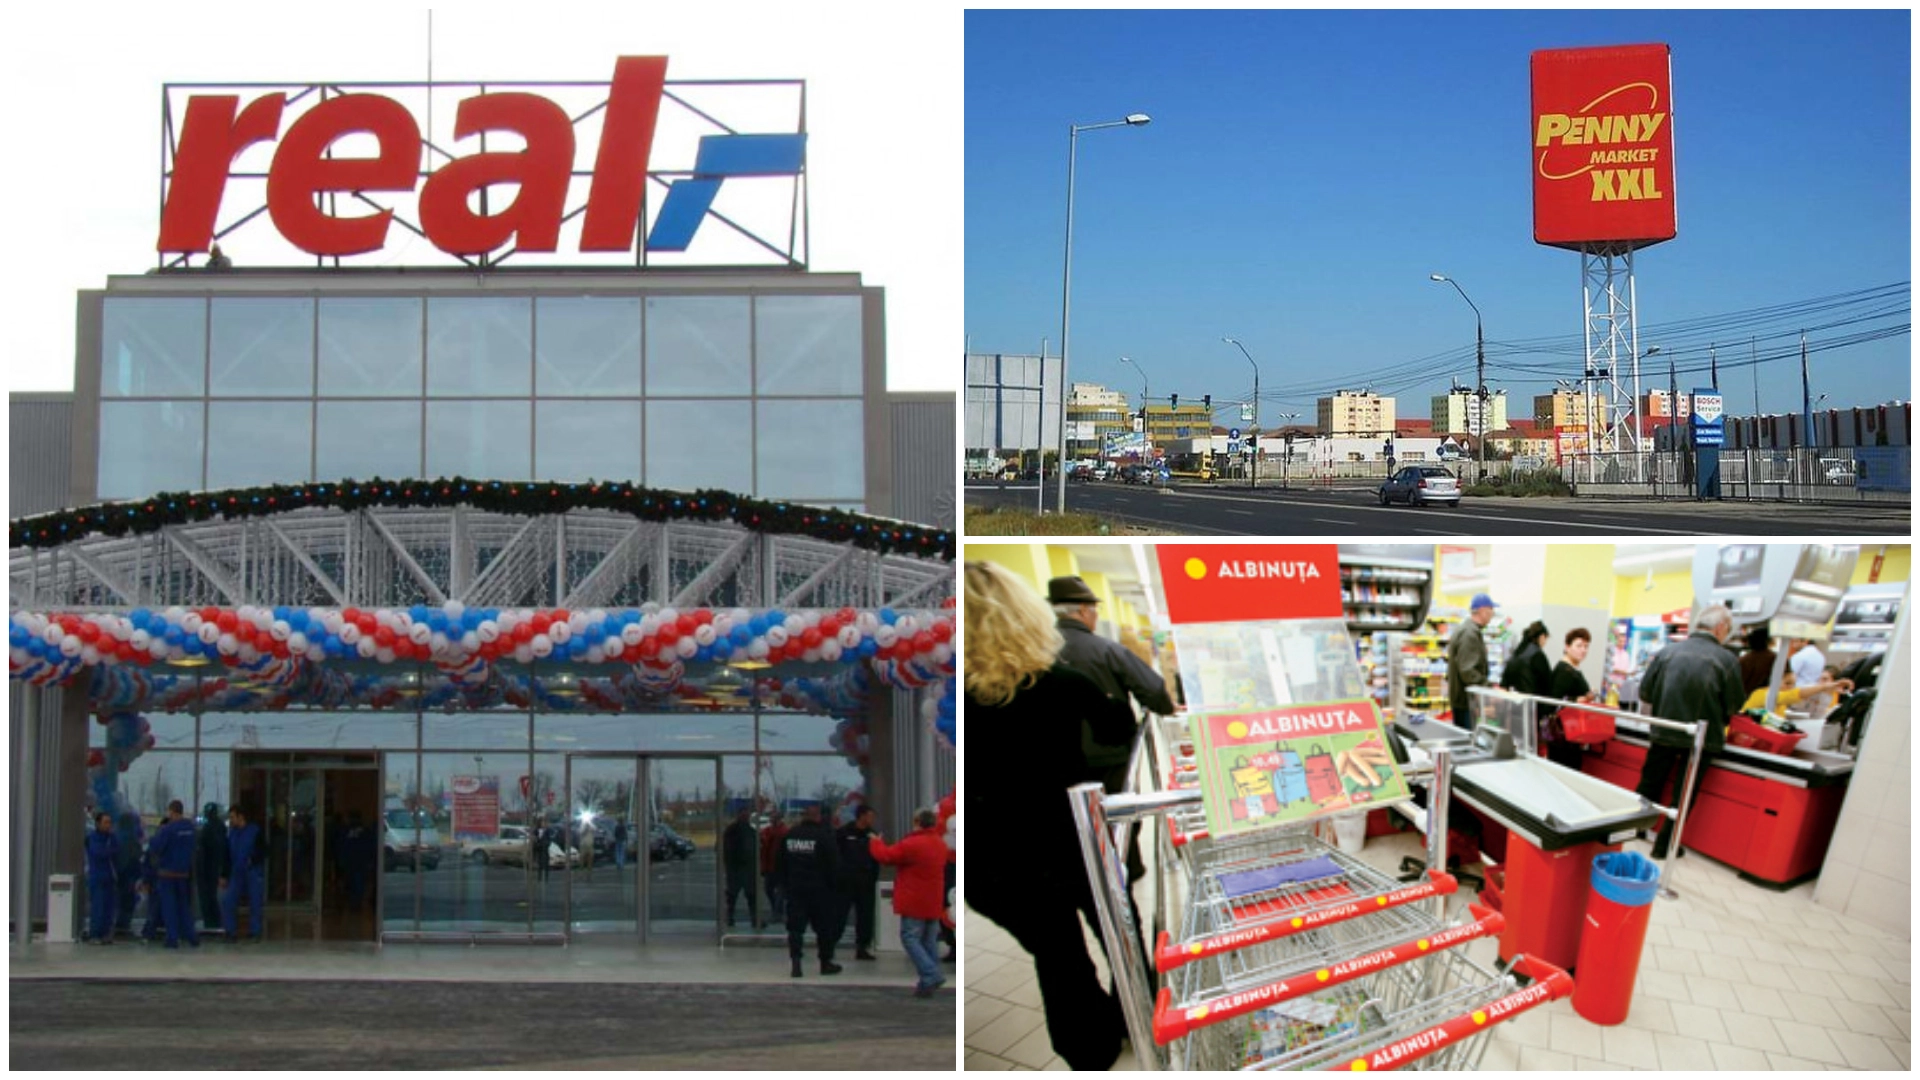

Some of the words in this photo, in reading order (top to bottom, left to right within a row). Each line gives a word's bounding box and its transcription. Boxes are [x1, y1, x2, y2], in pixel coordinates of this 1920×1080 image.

[1535, 112, 1666, 147] PENNY
[1590, 148, 1659, 164] MARKET
[1590, 167, 1663, 202] XXL
[1696, 397, 1721, 405] BOSCH
[786, 839, 817, 851] SWAT
